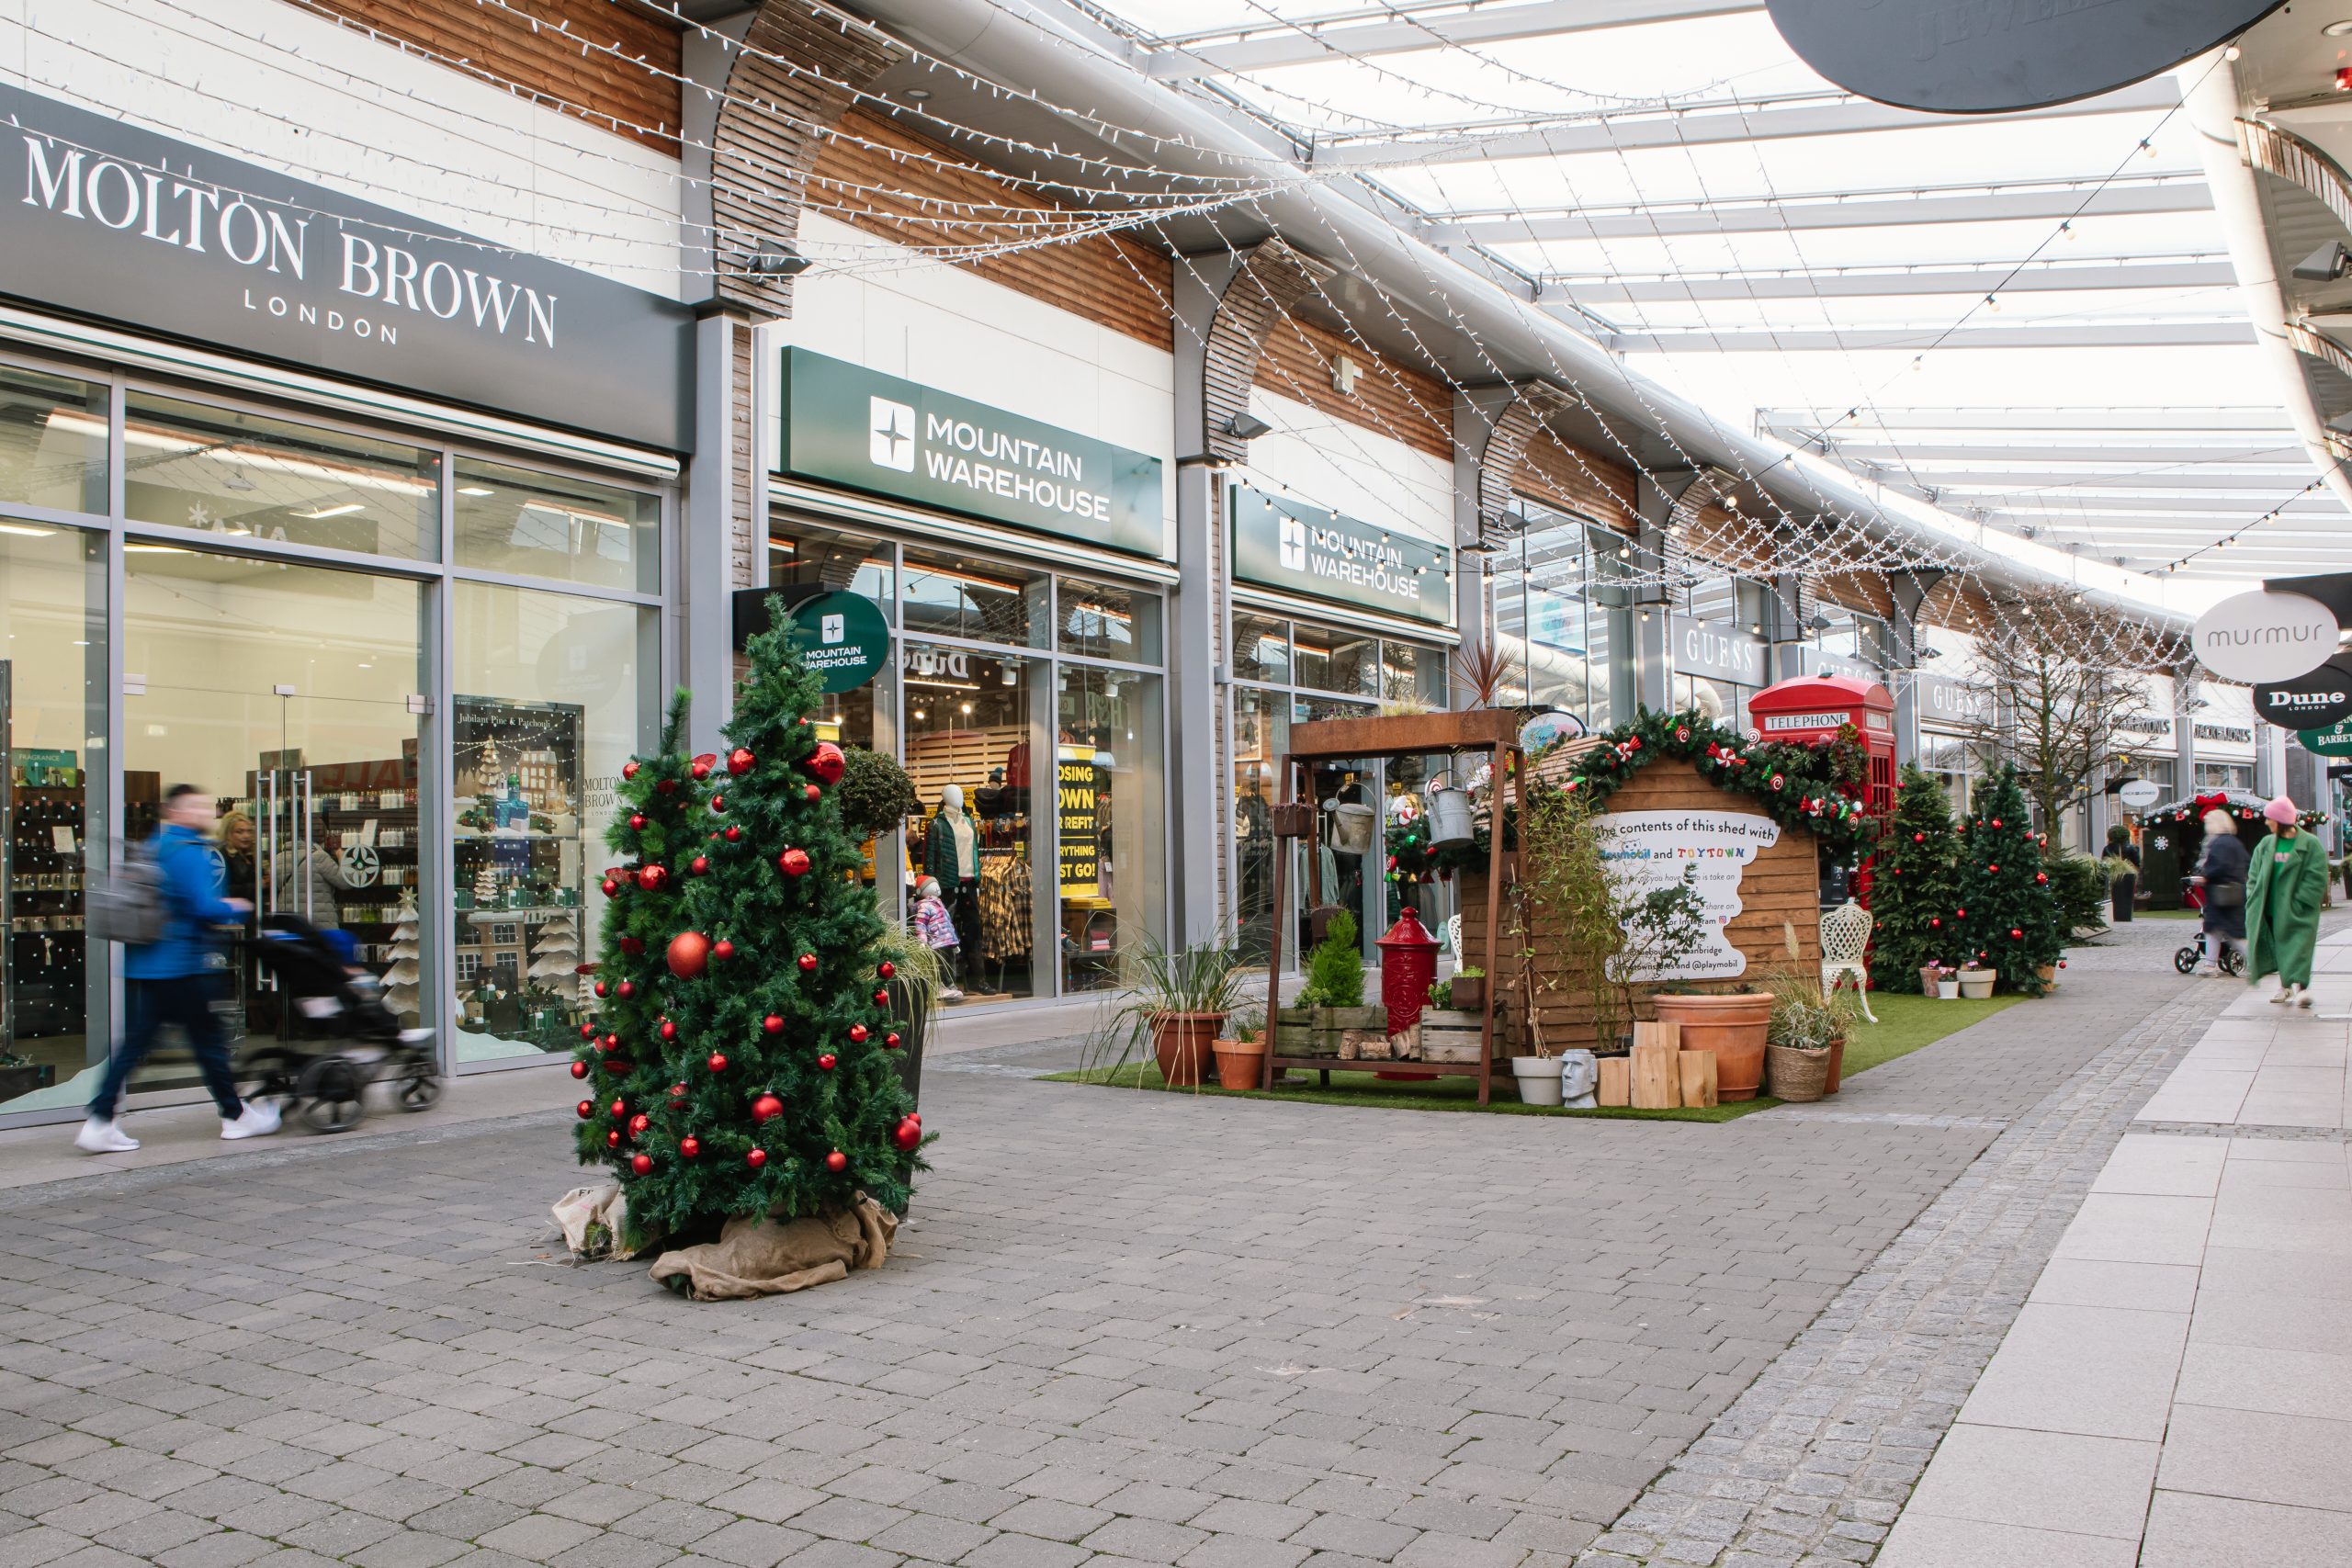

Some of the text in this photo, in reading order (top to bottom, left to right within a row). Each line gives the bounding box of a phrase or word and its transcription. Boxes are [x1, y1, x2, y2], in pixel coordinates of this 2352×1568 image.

[22, 135, 558, 348] MOLTON BROWN
[244, 288, 397, 344] LONDON
[927, 413, 1081, 481] MOUNTAIN
[924, 450, 1110, 522] WAREHOUSE
[1311, 525, 1402, 570] MOUNTAIN
[1310, 553, 1419, 599] WAREHOUSE
[2208, 624, 2323, 647] murmur
[806, 646, 861, 660] MOUNTAIN
[1686, 629, 1752, 672] GUESS
[2269, 692, 2346, 705] Dune
[458, 713, 550, 728] Jubilant Pine & Patchouli
[1770, 714, 1847, 728] TELEPHONE
[19, 753, 60, 761] FRAGRANCE
[1058, 766, 1093, 782] OSING
[1058, 789, 1094, 809] OWN
[1065, 817, 1093, 829] REFIT
[1620, 821, 1672, 834] contents
[1676, 818, 1690, 831] of
[1692, 819, 1714, 832] this
[1718, 821, 1746, 835] shed
[1749, 827, 1774, 841] with
[1059, 845, 1095, 857] RYTHING
[1654, 850, 1672, 859] and
[1678, 848, 1745, 858] TOYTOWN
[1075, 863, 1096, 878] GO!
[1710, 872, 1724, 881] take
[1706, 902, 1724, 910] share
[1692, 960, 1737, 972] @playmobil
